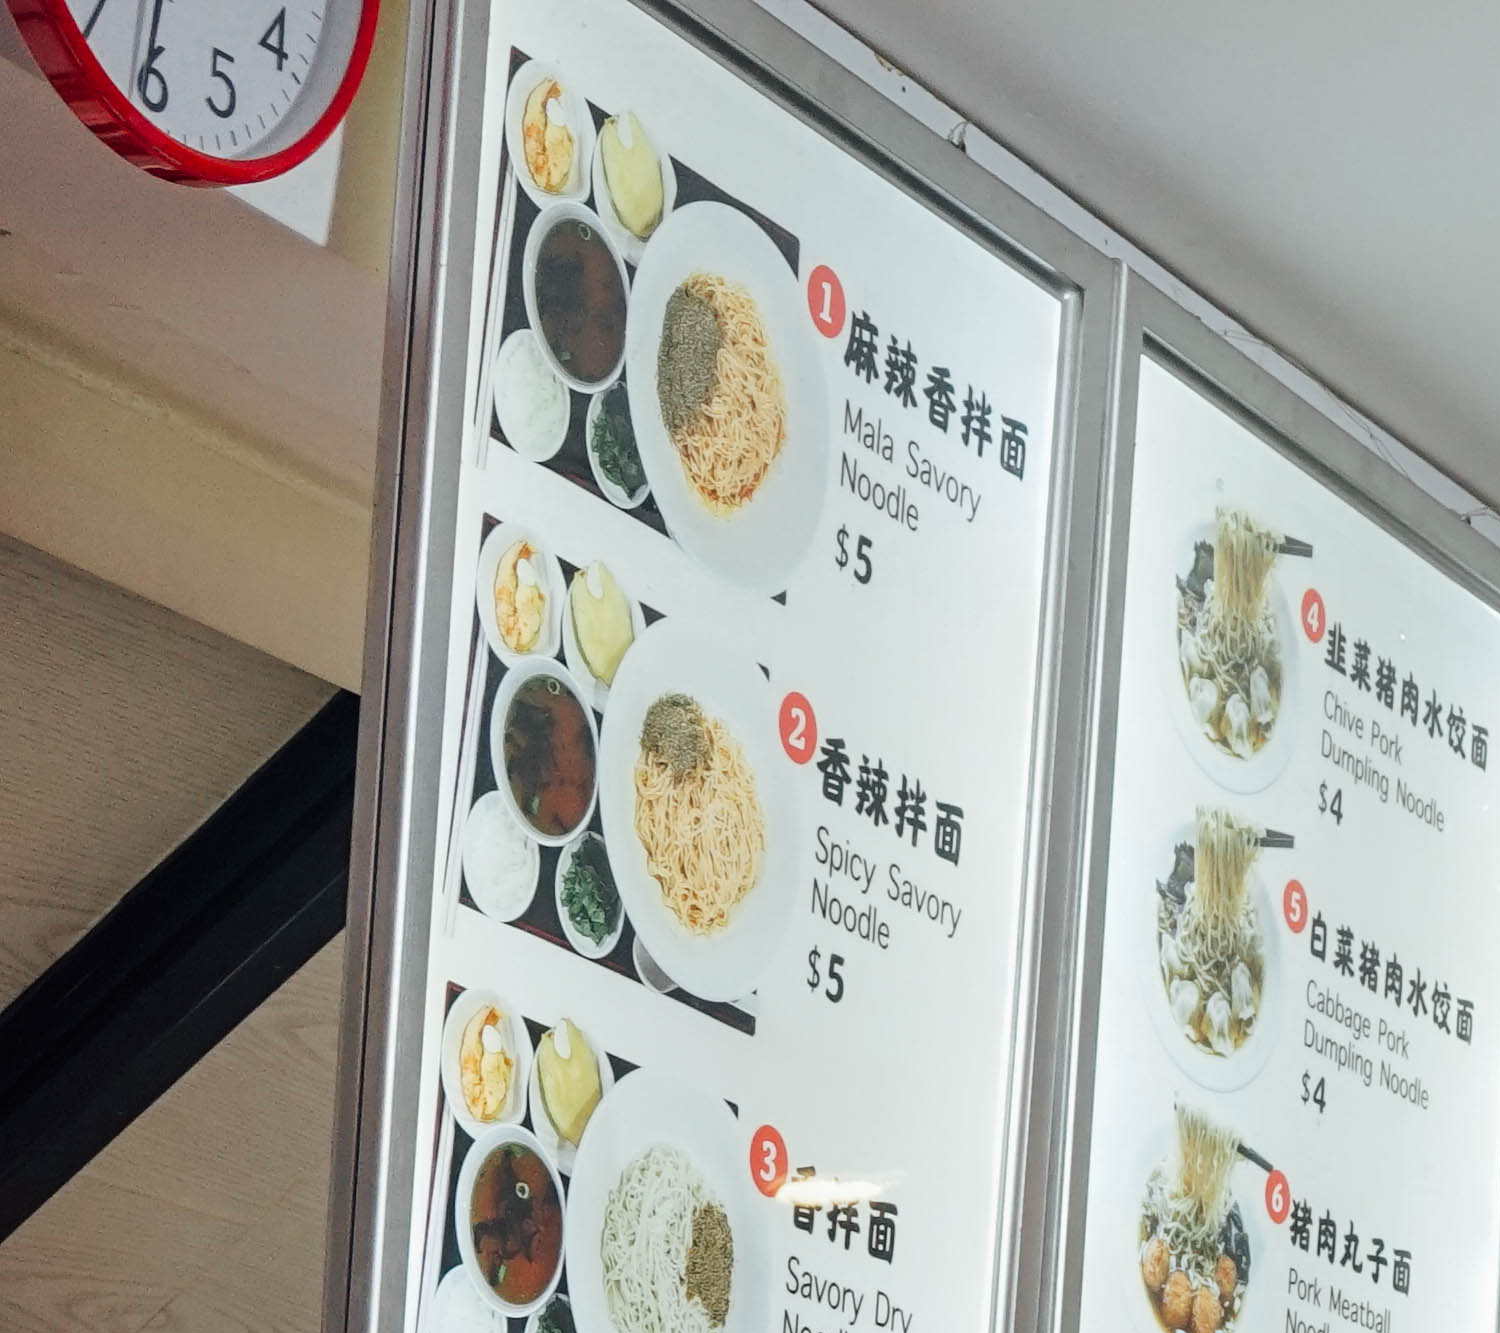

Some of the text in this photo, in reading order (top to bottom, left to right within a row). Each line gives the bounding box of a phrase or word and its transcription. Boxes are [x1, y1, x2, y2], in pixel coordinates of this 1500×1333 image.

[260, 7, 288, 71] 4
[138, 45, 169, 112] 6
[206, 47, 236, 118] 5
[819, 278, 836, 327] 1
[843, 310, 1029, 482] 麻辣香拌面
[840, 451, 919, 533] Noodle
[843, 398, 982, 524] Mala Savory
[1306, 598, 1321, 636] 4
[788, 704, 808, 752] 2
[1323, 622, 1489, 772] 韭菜猪肉水饺面
[1323, 689, 1403, 766] Chive Pork
[815, 737, 965, 868] 香辣拌面
[1320, 728, 1445, 833] Dumpling Noodle
[811, 877, 890, 951] Noodle
[815, 824, 962, 939] Spicy Savory
[1289, 889, 1303, 926] 5
[1309, 910, 1475, 1045] 白菜猪肉水饺面
[1306, 978, 1410, 1060] Cabbage Pork
[1303, 1018, 1430, 1111] Dumpling Noodle
[759, 1139, 778, 1185] 3
[1271, 1180, 1286, 1218] 6
[1289, 1198, 1412, 1297] 猪肉丸子面
[785, 1255, 865, 1327] Savory
[1287, 1266, 1322, 1308] Pork
